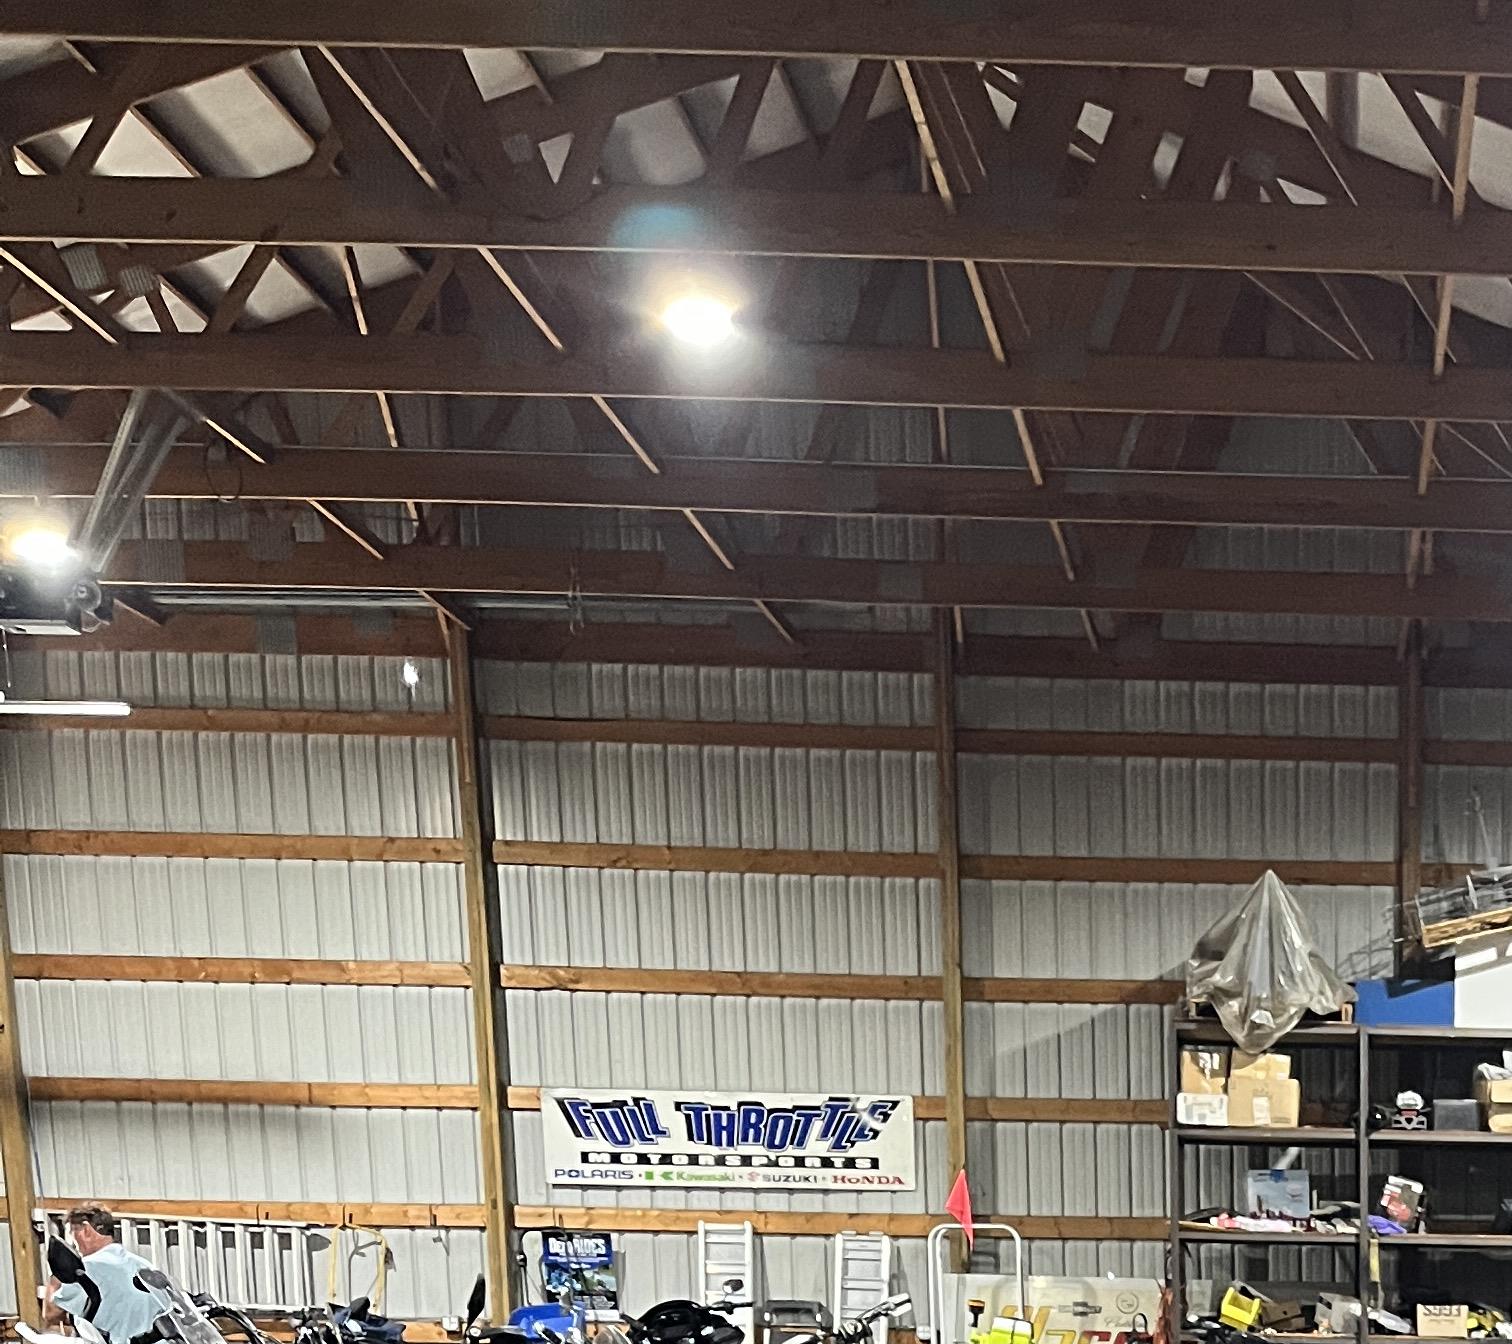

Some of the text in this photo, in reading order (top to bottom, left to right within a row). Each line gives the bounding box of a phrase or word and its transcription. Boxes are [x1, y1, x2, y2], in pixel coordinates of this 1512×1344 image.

[555, 1096, 900, 1152] FULL THROTTLE
[588, 1152, 873, 1169] MOTORSPORTS
[555, 1168, 905, 1185] POLARIS Kawasaki SUZUKI HONDA
